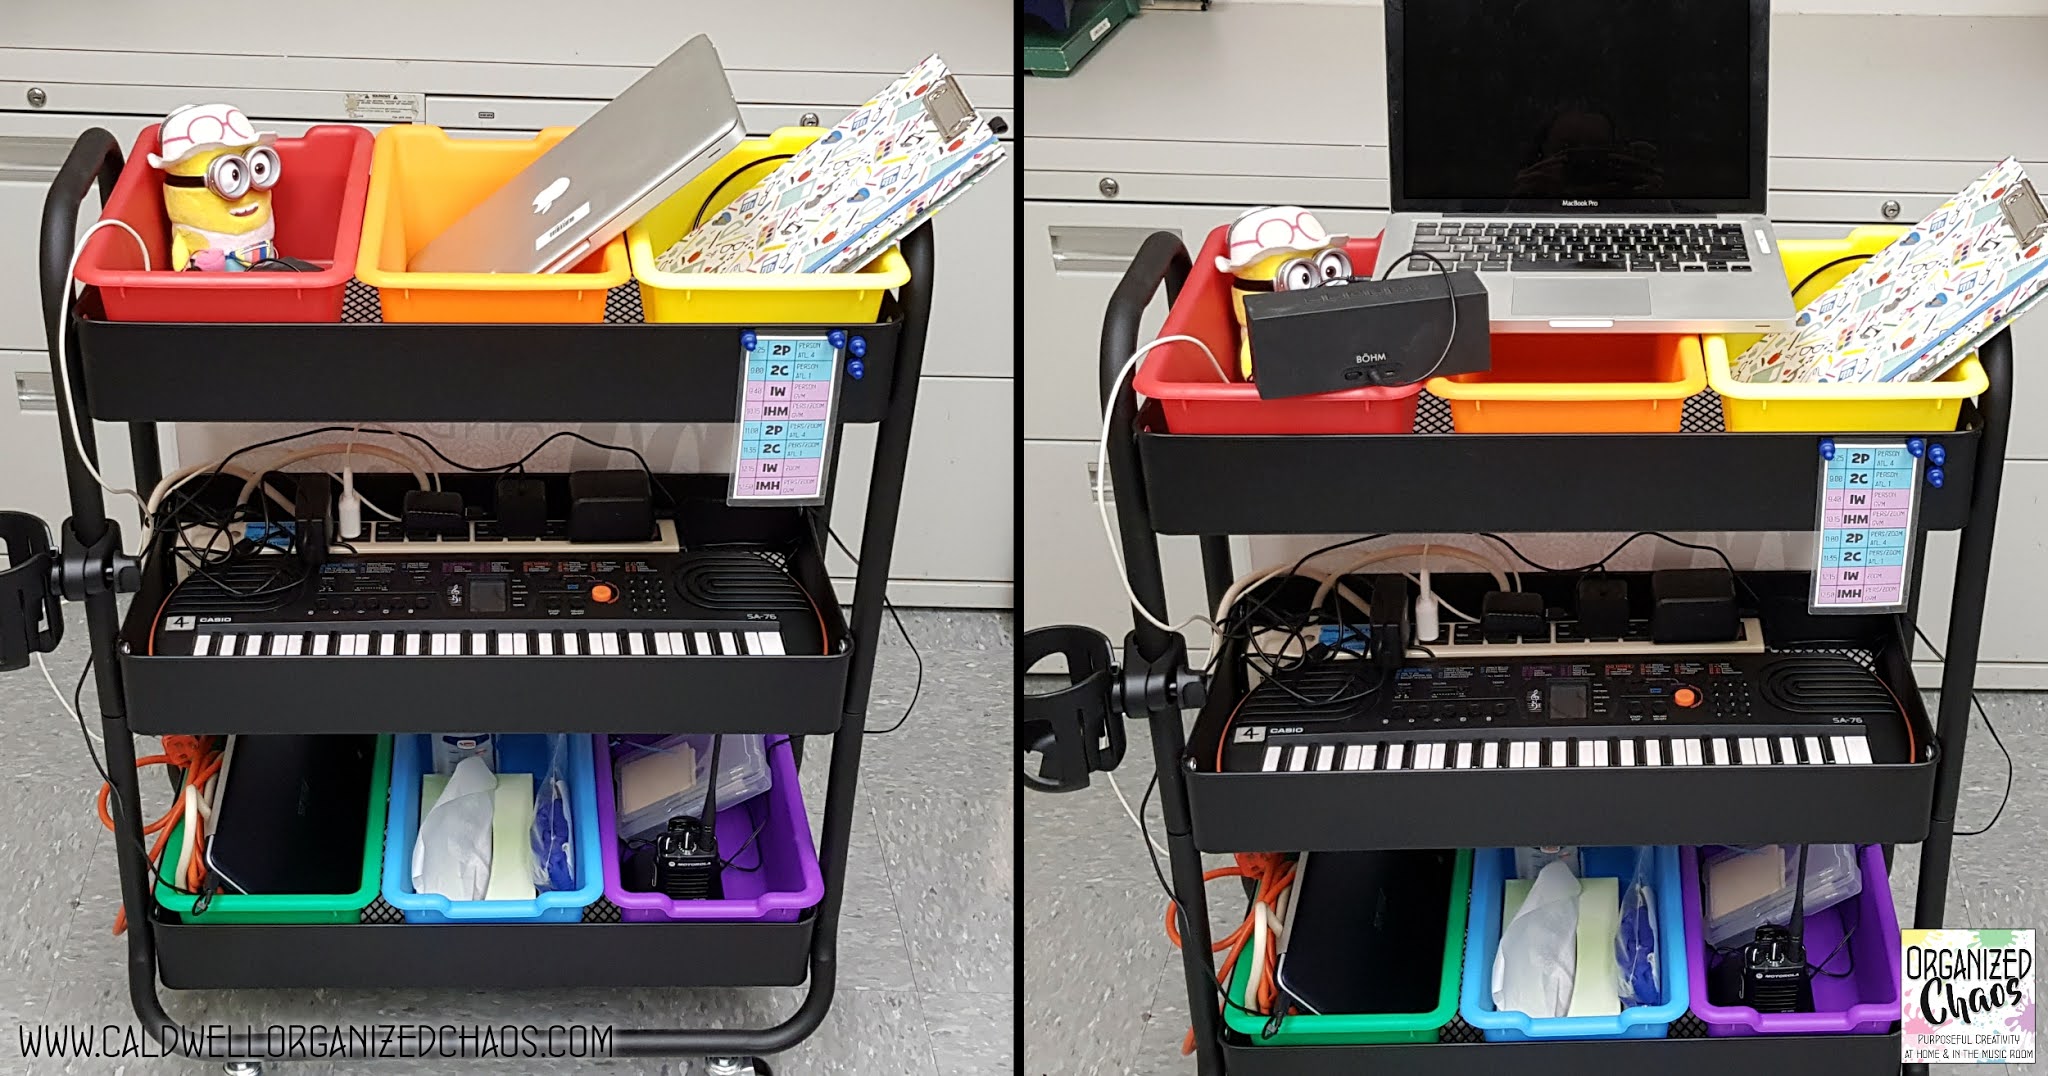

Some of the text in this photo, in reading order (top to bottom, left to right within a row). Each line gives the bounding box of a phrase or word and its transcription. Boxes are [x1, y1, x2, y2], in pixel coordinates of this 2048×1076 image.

[1562, 199, 1599, 207] MacBook Pro
[772, 345, 791, 356] 2P
[770, 365, 789, 376] 2C
[765, 425, 783, 436] 2P
[762, 444, 781, 454] 2C
[1851, 453, 1870, 464] 2P
[1849, 473, 1869, 484] 2C
[1845, 533, 1863, 544] 2P
[1843, 551, 1862, 562] 2C
[173, 616, 190, 628] 4
[1242, 727, 1260, 740] 4
